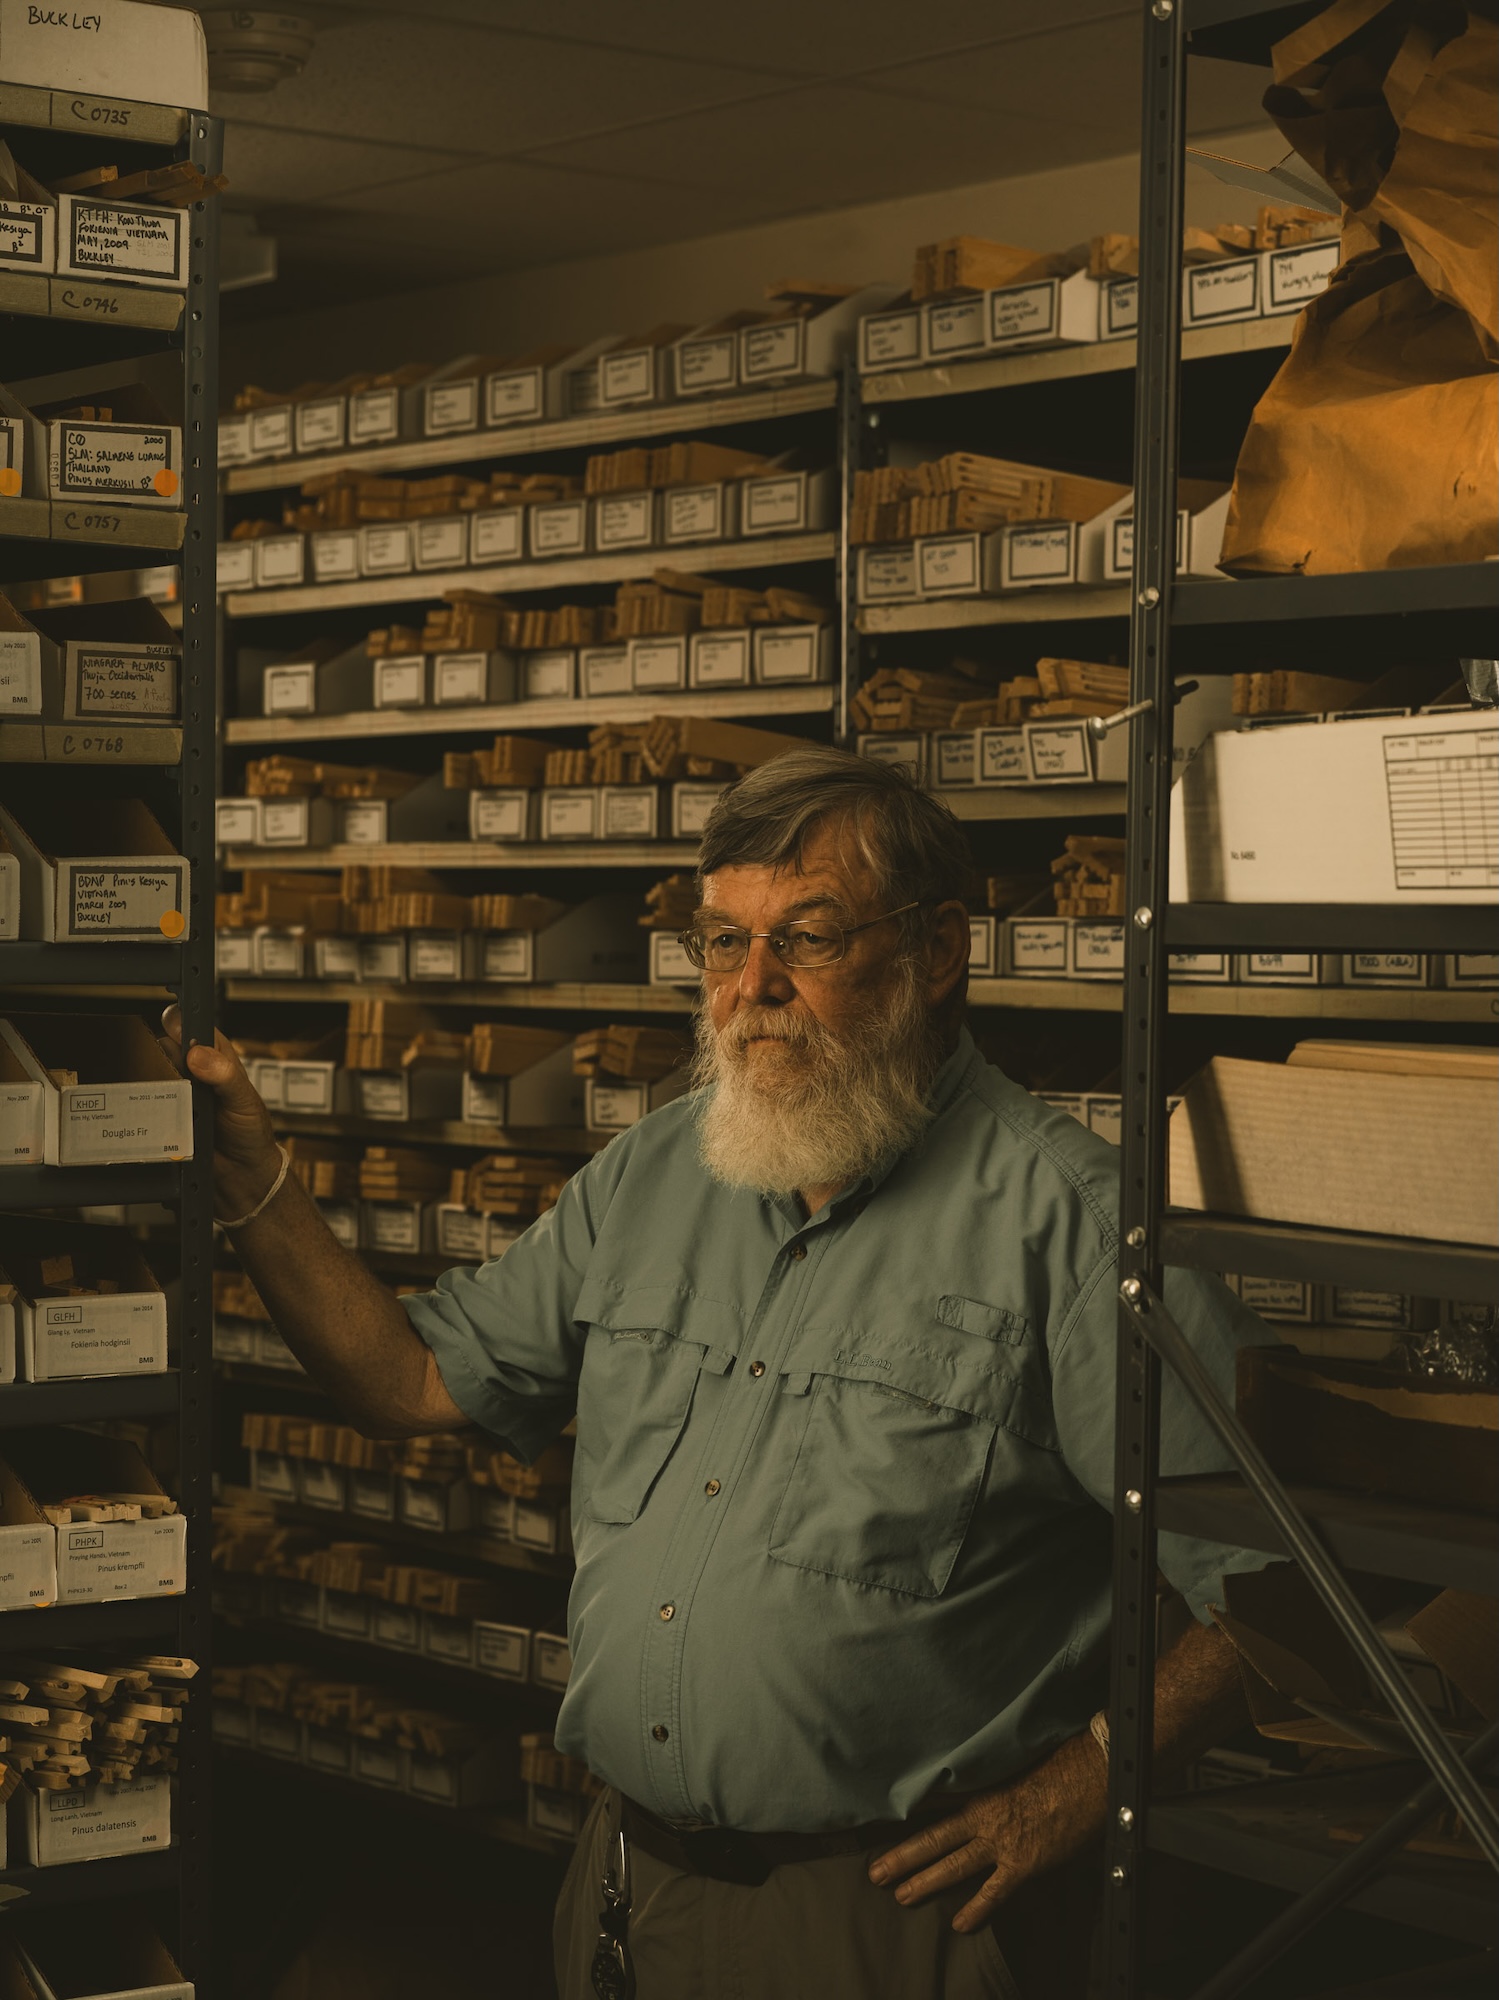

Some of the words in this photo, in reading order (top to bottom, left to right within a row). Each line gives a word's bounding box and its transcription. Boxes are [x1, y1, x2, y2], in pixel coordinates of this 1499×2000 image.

[28, 5, 101, 33] BUCKLEY
[91, 108, 131, 125] 0735
[126, 229, 169, 241] VIETNAM
[78, 248, 114, 264] BUCKLEY
[83, 297, 119, 313] 0746
[144, 436, 164, 444] 2000
[66, 461, 111, 474] THAILAND
[68, 473, 93, 485] PINUS
[65, 511, 80, 530] C
[84, 516, 121, 532] 0757
[83, 658, 124, 669] NIAGARA
[131, 661, 166, 672] ALVARS
[84, 687, 105, 700] 700
[110, 690, 137, 700] series
[63, 736, 76, 755] C
[83, 737, 124, 753] 0768
[77, 890, 117, 898] VIETNAM
[76, 901, 104, 912] MARCH
[108, 901, 127, 910] 2009
[77, 912, 111, 924] BUCKLEY
[76, 1099, 100, 1109] KHDF
[102, 1128, 135, 1139] Douglas
[137, 1127, 148, 1136] Fir
[53, 1312, 75, 1322] GLFH
[70, 1340, 99, 1349] Fokienia
[100, 1339, 131, 1348] hodginsii
[139, 1356, 154, 1364] BMB
[75, 1537, 97, 1547] PHPK
[97, 1564, 116, 1572] Pinus
[158, 1579, 174, 1587] BMB
[29, 1590, 45, 1598] BMB
[57, 1797, 78, 1808] LLPD
[72, 1826, 94, 1836] Pinus
[96, 1819, 137, 1832] dalatensis
[142, 1835, 157, 1843] BMB
